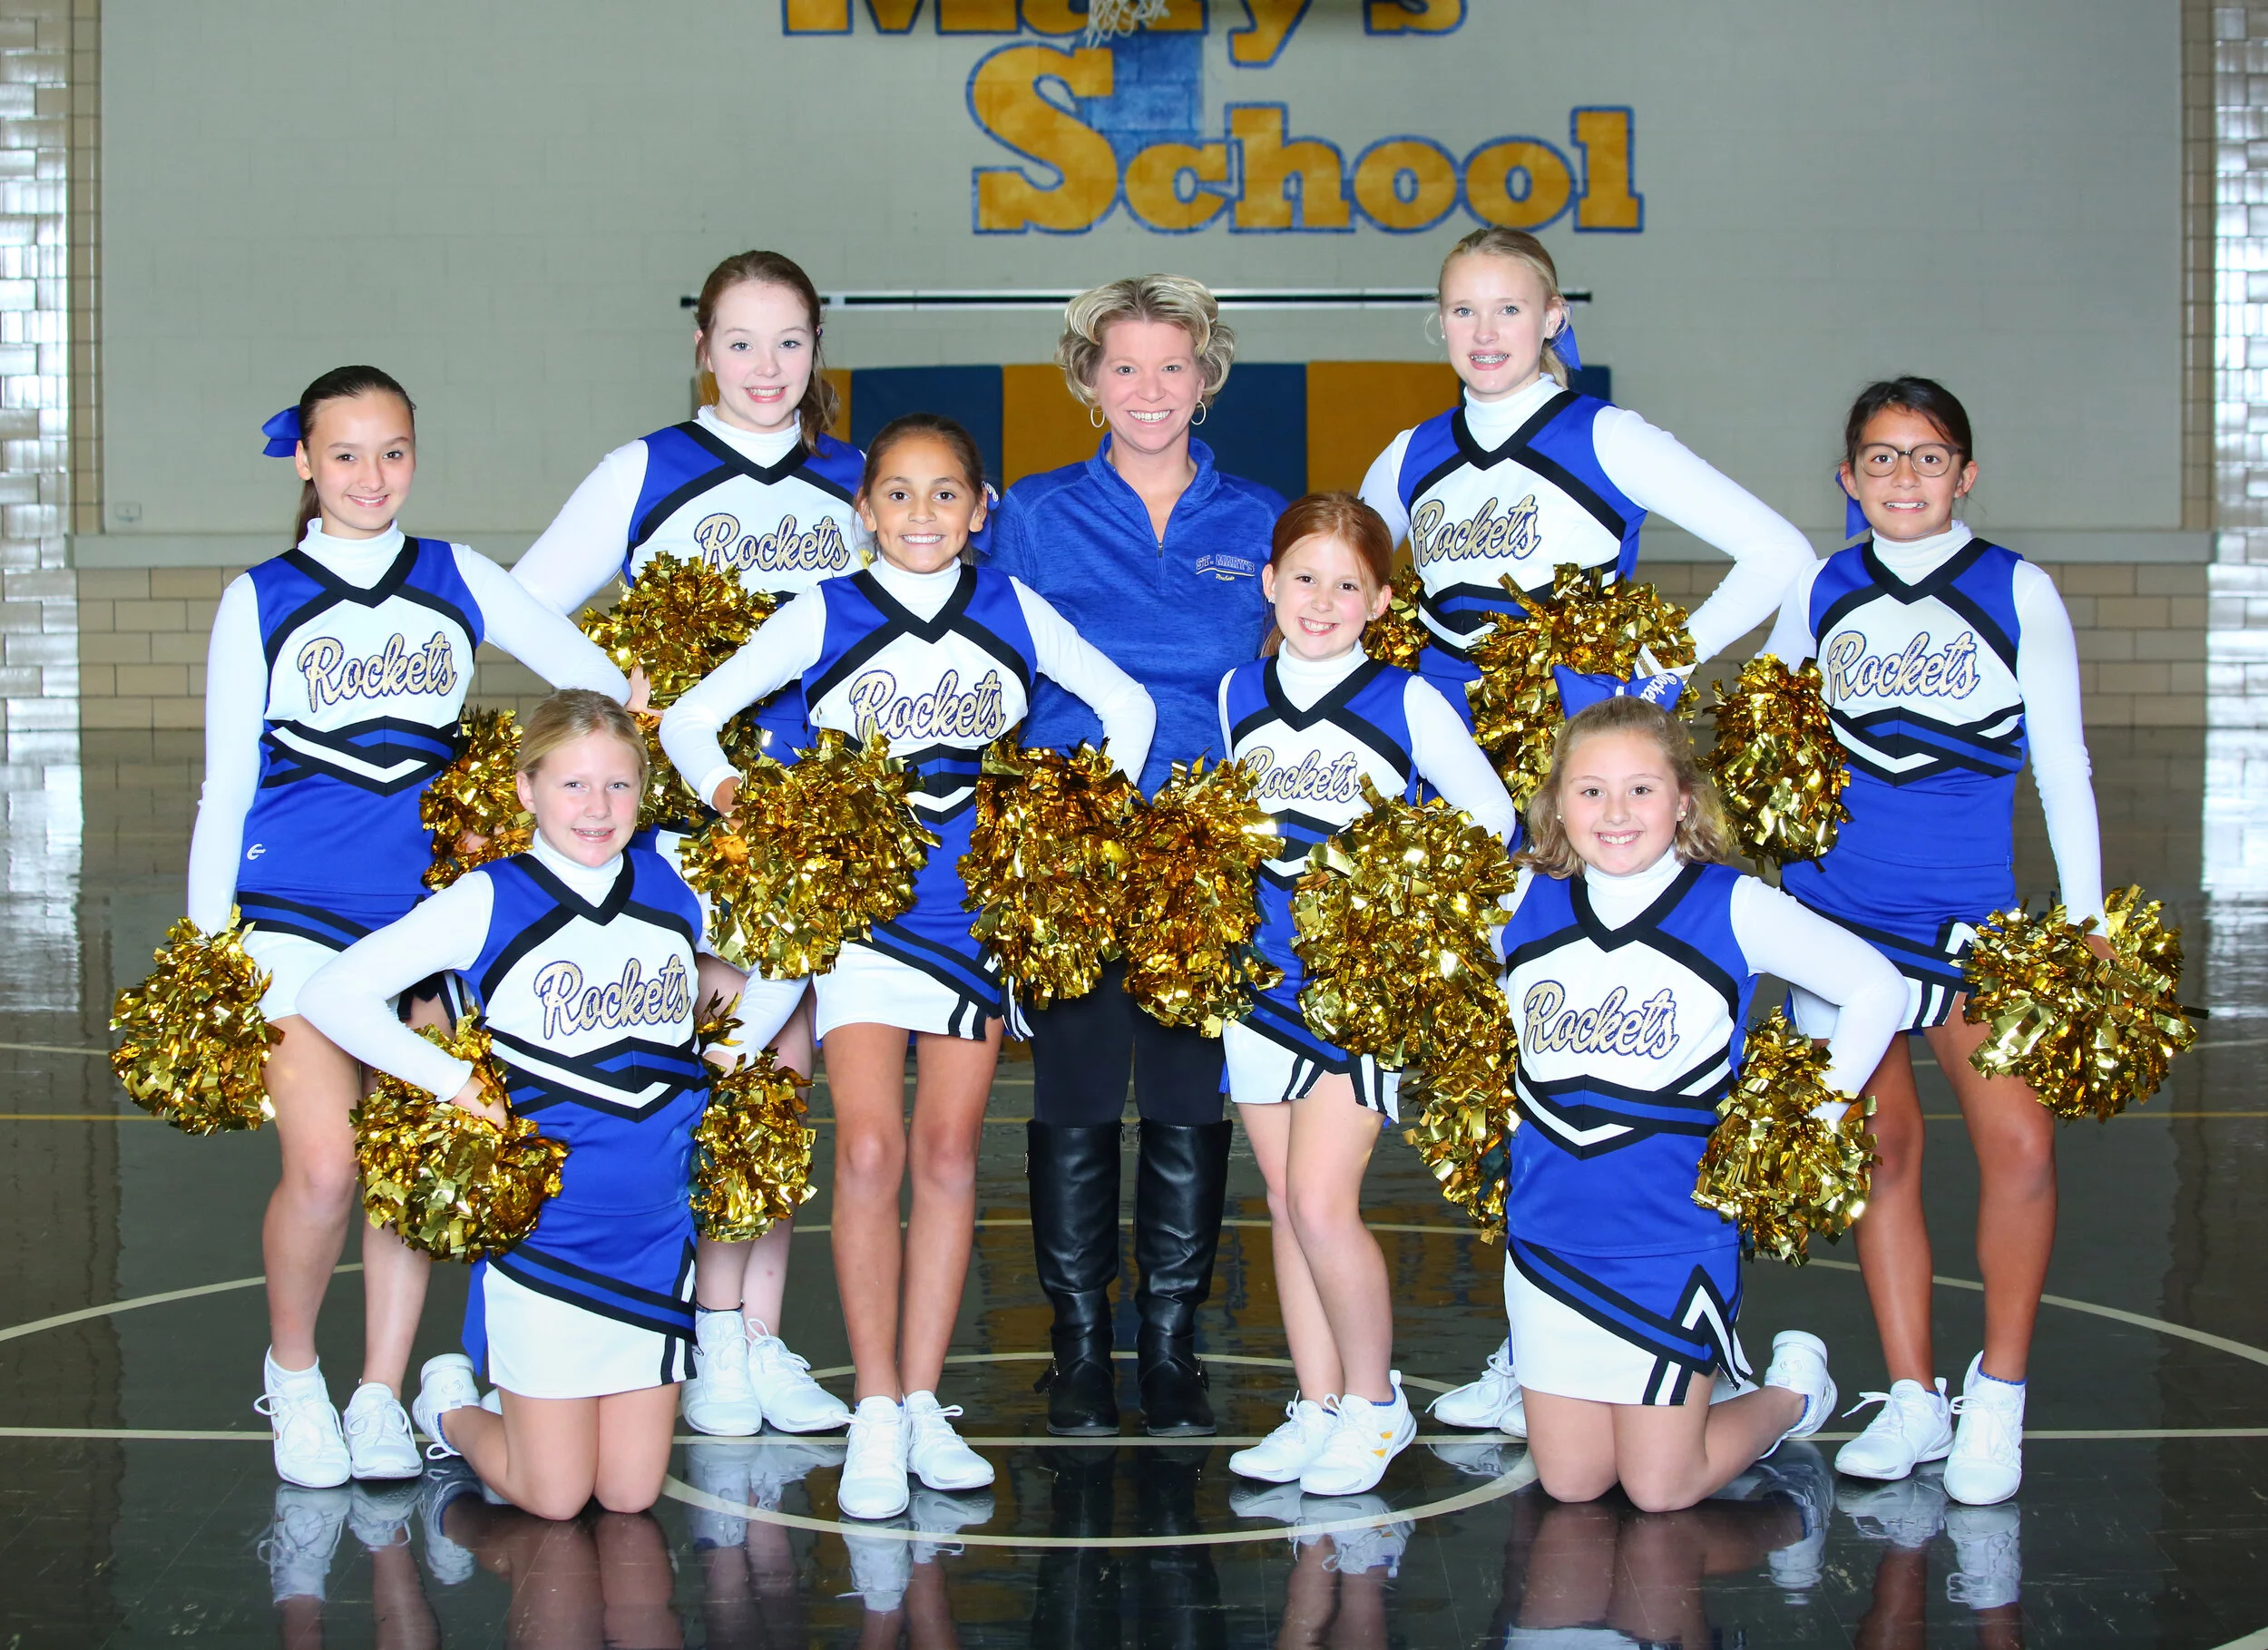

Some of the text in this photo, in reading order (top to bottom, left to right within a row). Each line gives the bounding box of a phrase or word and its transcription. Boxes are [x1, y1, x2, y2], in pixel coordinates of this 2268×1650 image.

[965, 41, 1644, 234] School
[694, 513, 851, 573] Rockets
[1412, 494, 1542, 573] Rockets
[297, 631, 457, 713] Rockets
[849, 669, 1007, 744] Rockets
[1639, 673, 1677, 704] Rocket
[1827, 630, 1981, 707] Rockets
[1244, 746, 1360, 804] Rockets
[533, 953, 691, 1040] Rockets
[1523, 979, 1680, 1059] Rockets
